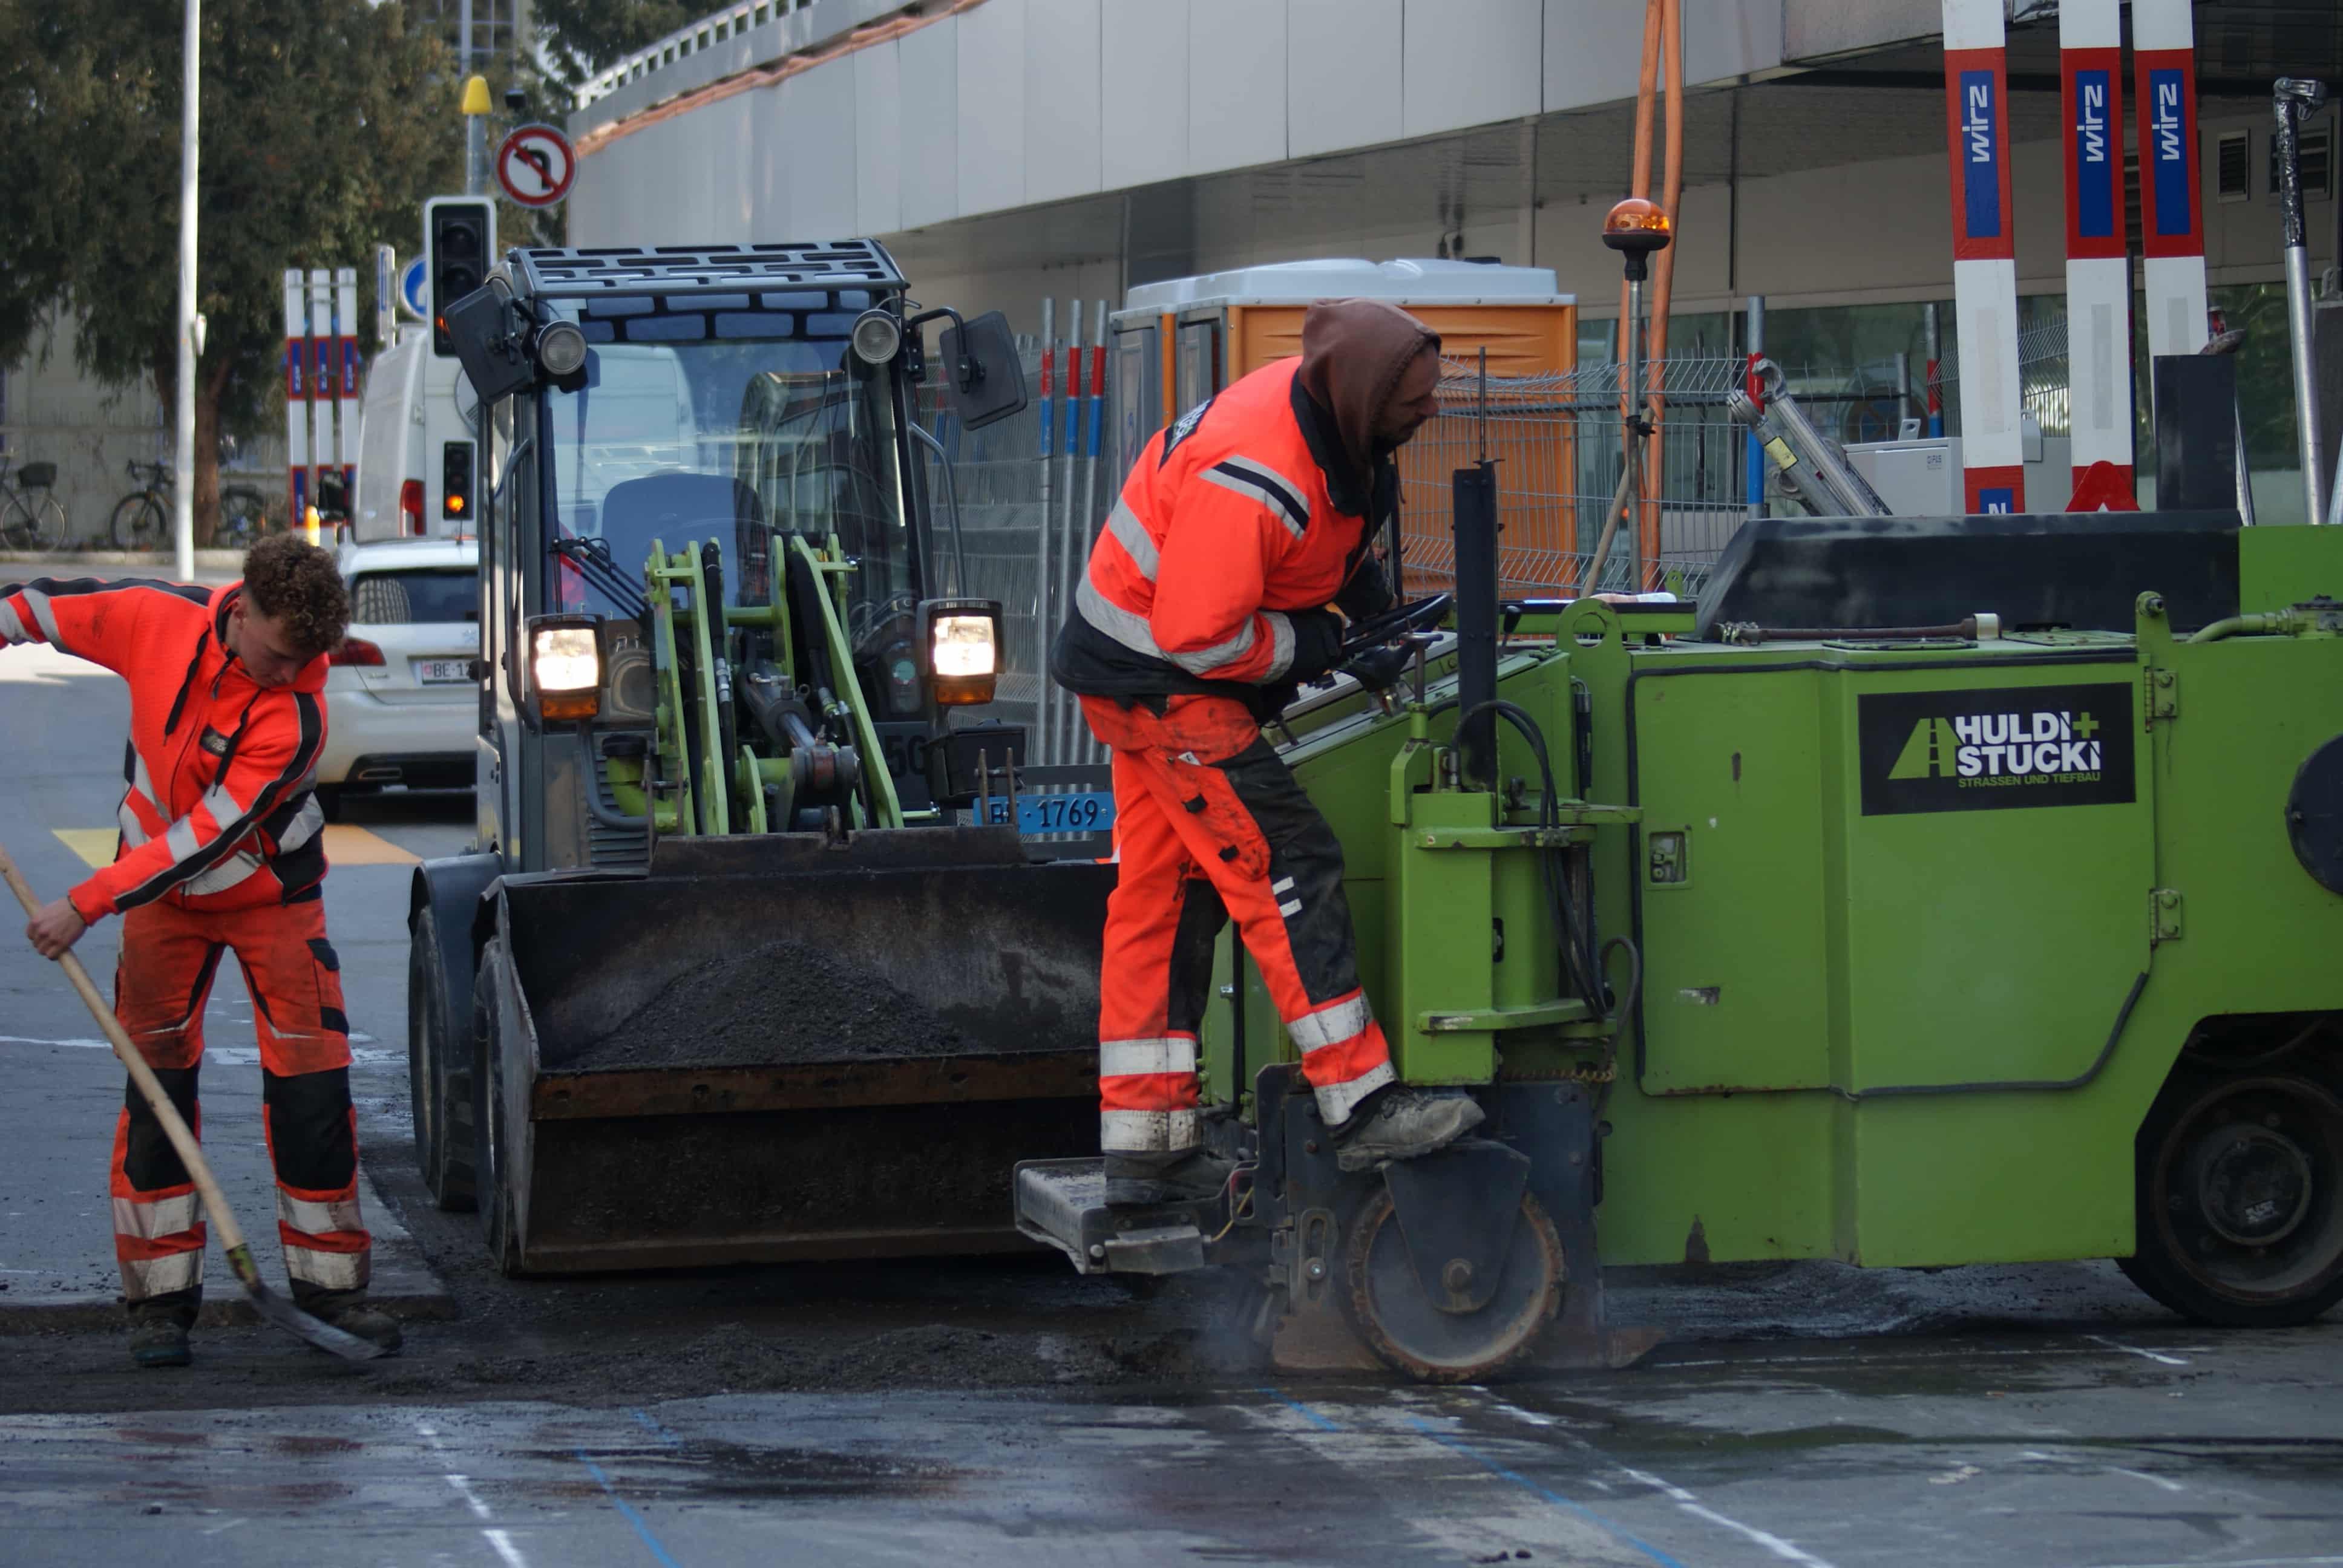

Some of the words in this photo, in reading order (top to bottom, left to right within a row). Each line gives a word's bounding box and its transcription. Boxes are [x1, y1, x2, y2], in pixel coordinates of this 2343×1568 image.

[1962, 85, 1990, 163] wirz
[2077, 85, 2104, 162] wirz
[2152, 83, 2180, 160] wirz
[1957, 740, 2101, 777] STUCKI
[1958, 776, 2022, 788] STRASSEN
[2024, 774, 2049, 785] UND
[2052, 772, 2101, 783] TIEFBAU
[1037, 798, 1098, 828] 1769
